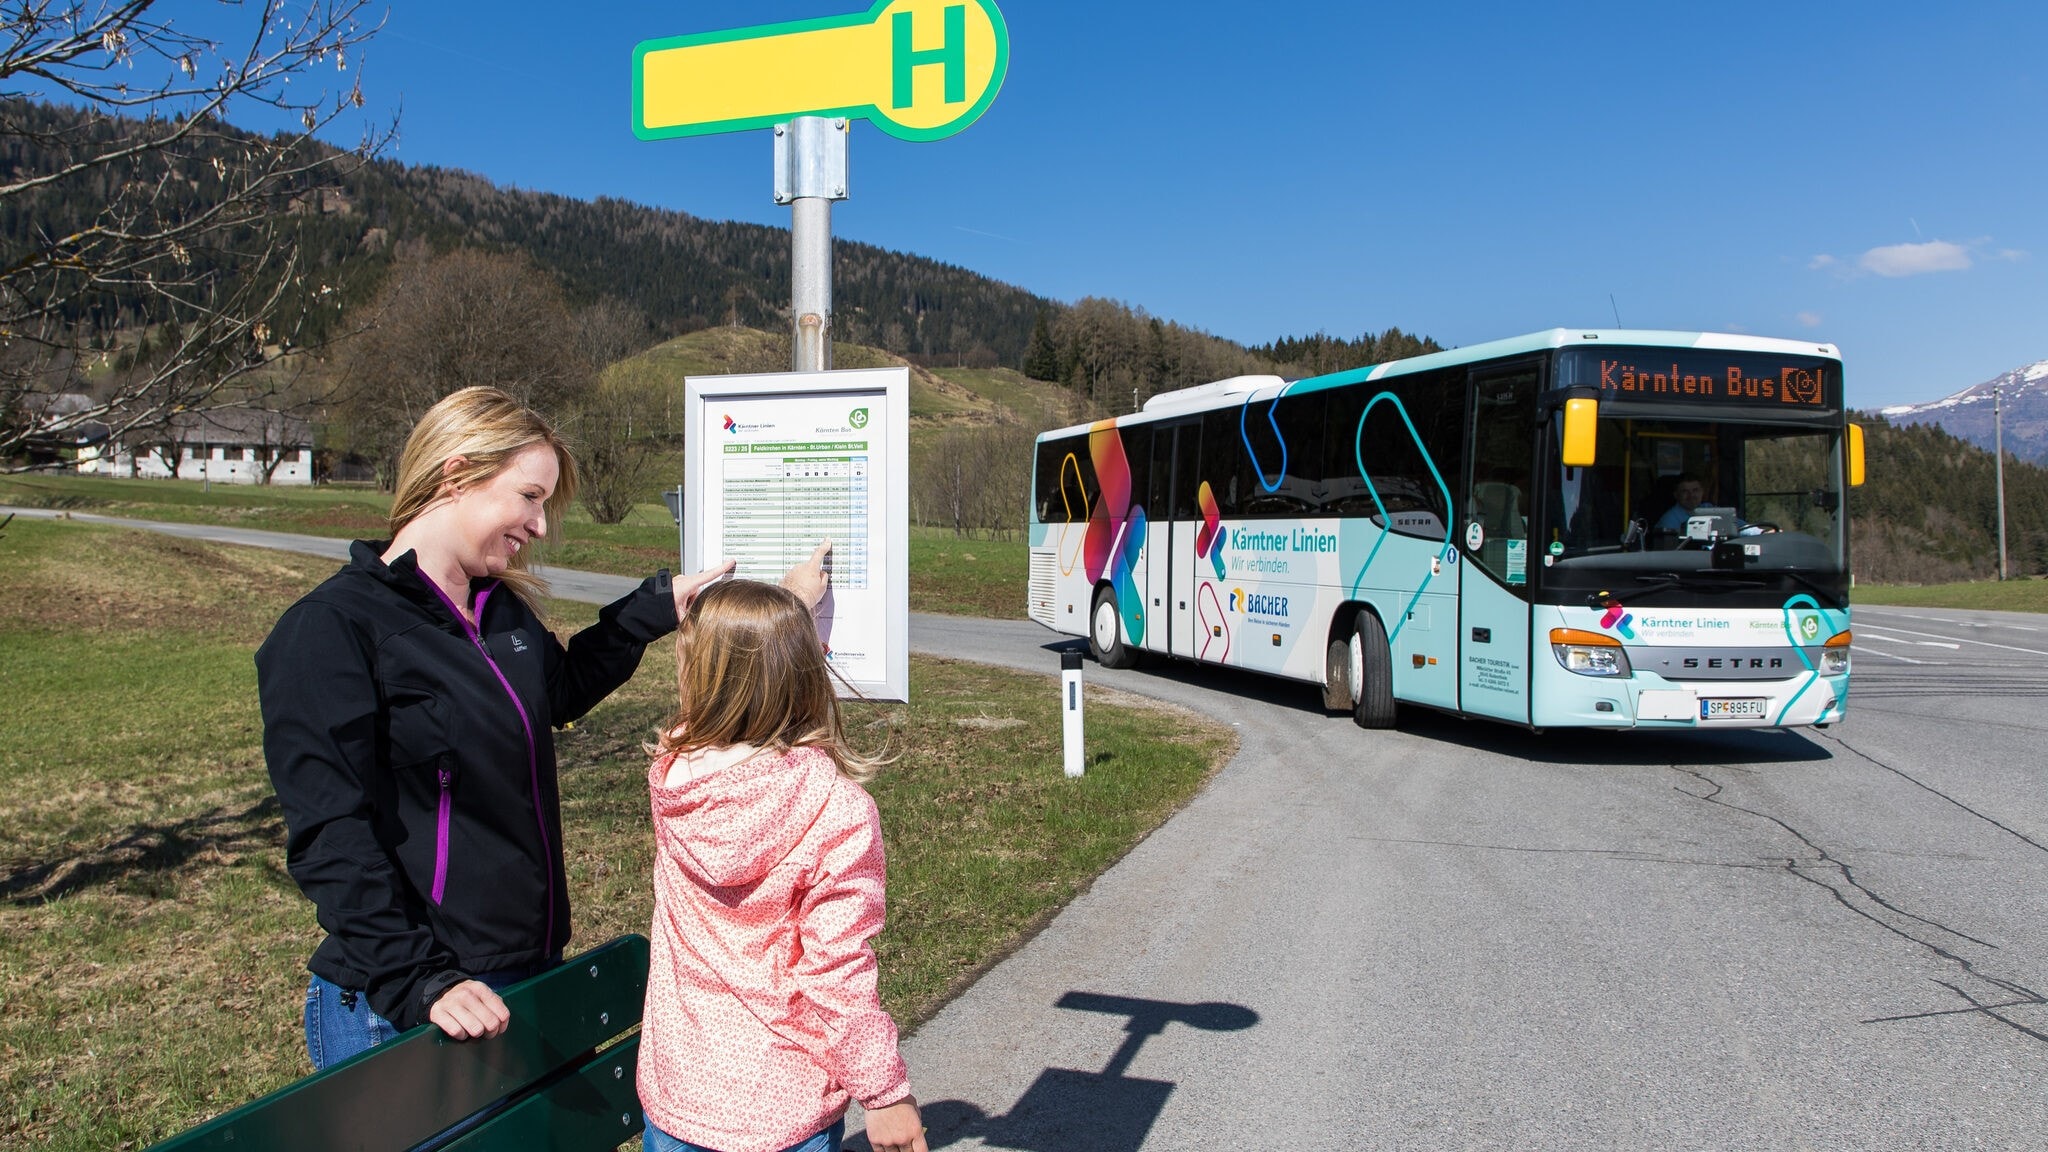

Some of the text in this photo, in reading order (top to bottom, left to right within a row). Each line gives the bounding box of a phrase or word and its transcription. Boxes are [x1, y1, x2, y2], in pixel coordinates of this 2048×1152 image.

[892, 5, 965, 109] H
[1601, 360, 1775, 397] Kärnten Bus
[1398, 518, 1431, 526] SETRA
[1232, 527, 1337, 553] Kärntner Linien
[1231, 556, 1290, 574] Wir verbinden.
[1248, 593, 1289, 617] BACHER
[1641, 616, 1730, 629] Kärntner Linien
[1683, 658, 1782, 668] SETRA
[1710, 701, 1762, 714] SP 895 FU
